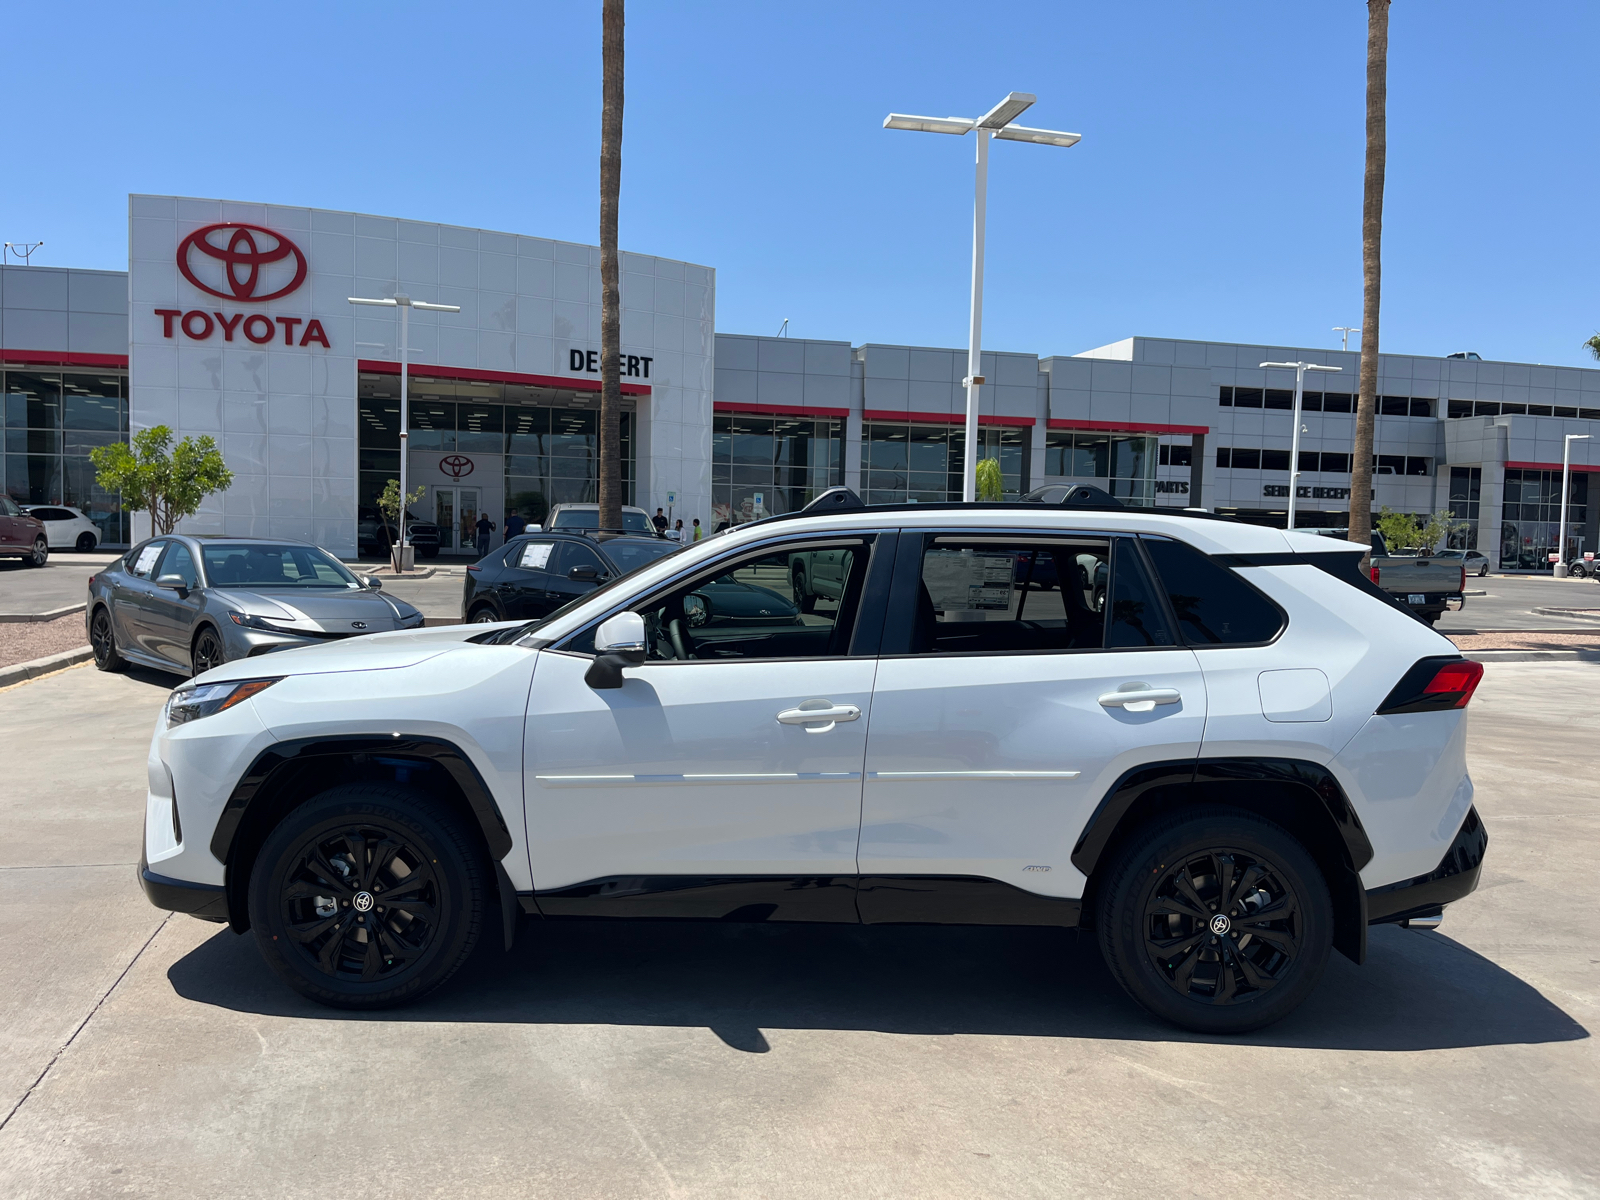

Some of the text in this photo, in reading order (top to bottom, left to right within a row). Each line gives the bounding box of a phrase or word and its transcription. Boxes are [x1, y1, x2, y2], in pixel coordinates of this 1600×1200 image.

[154, 309, 331, 348] TOYOTA
[570, 349, 653, 378] DEERT
[1263, 484, 1311, 498] SERVCE
[358, 803, 438, 842] DUNLOP
